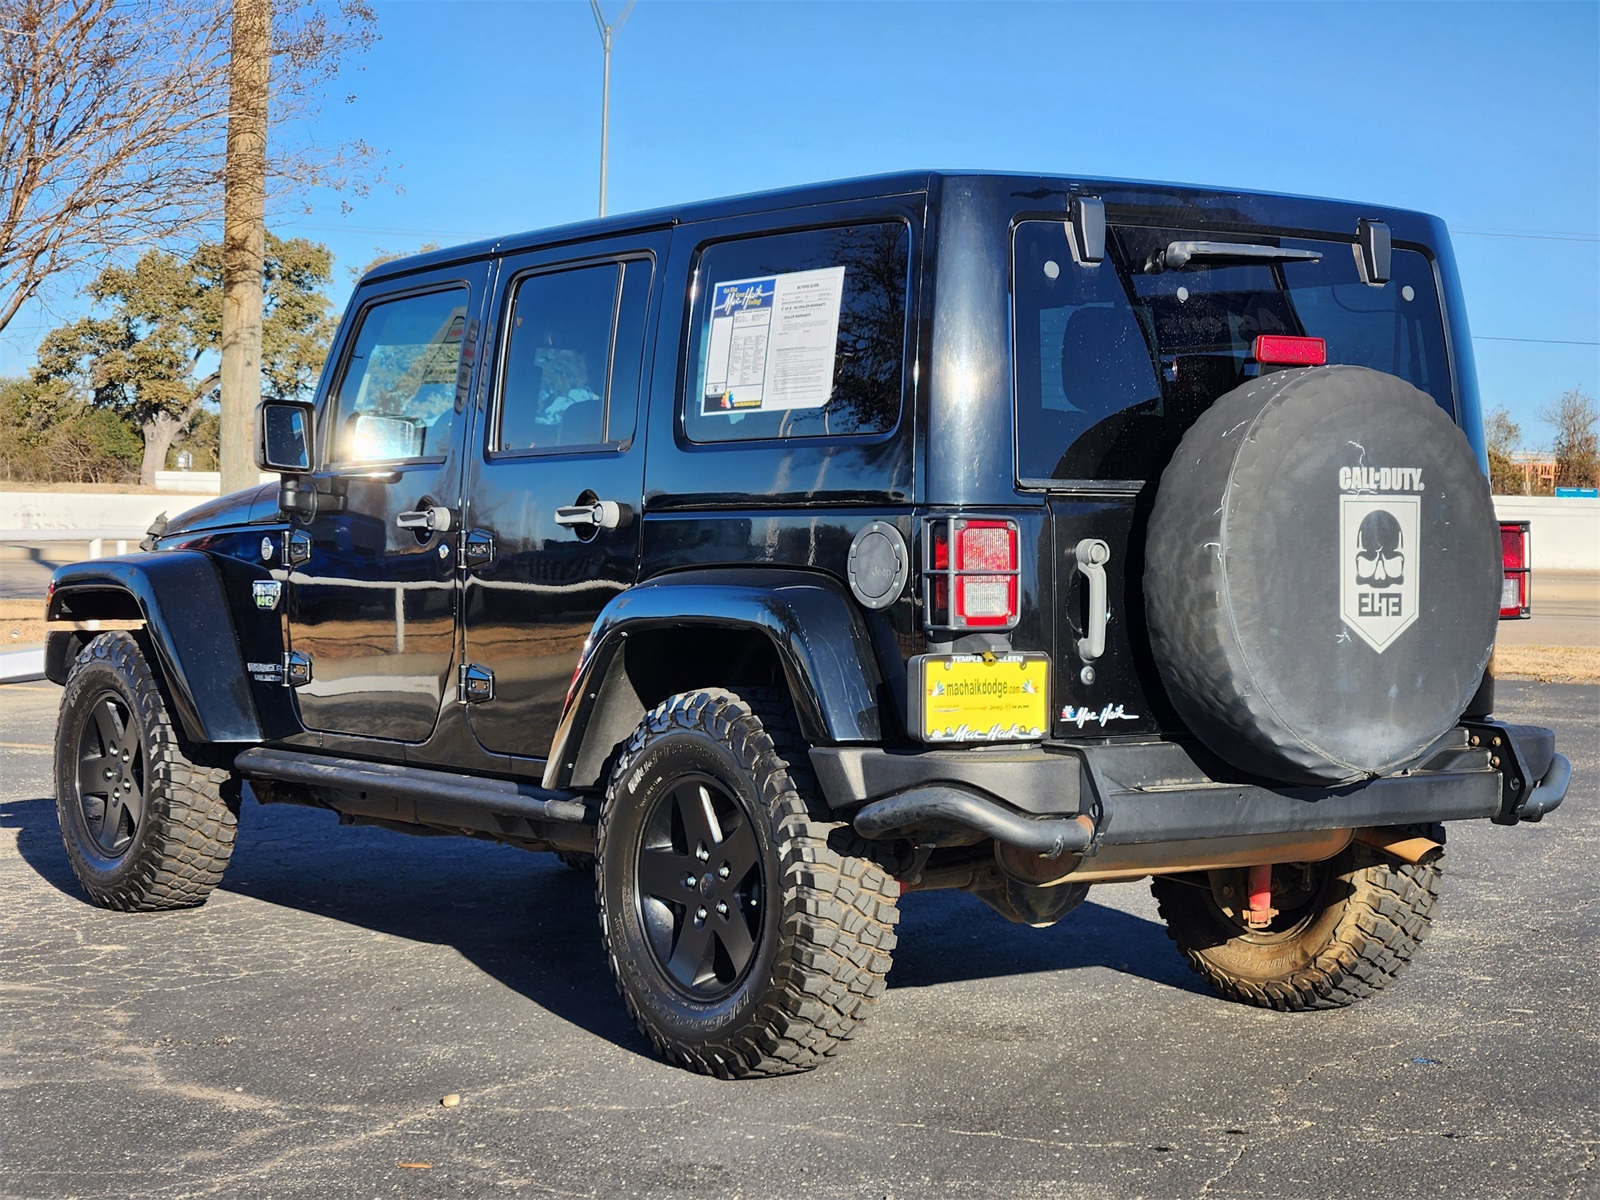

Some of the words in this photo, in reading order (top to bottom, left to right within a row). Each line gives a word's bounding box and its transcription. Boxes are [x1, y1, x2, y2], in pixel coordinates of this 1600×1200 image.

[1339, 466, 1377, 490] CALL
[872, 566, 891, 578] Jeep
[952, 655, 983, 663] TEMPLE
[1076, 706, 1098, 729] Mac
[1099, 703, 1139, 727] Haik
[950, 724, 986, 742] Mac
[985, 723, 1030, 741] Haik
